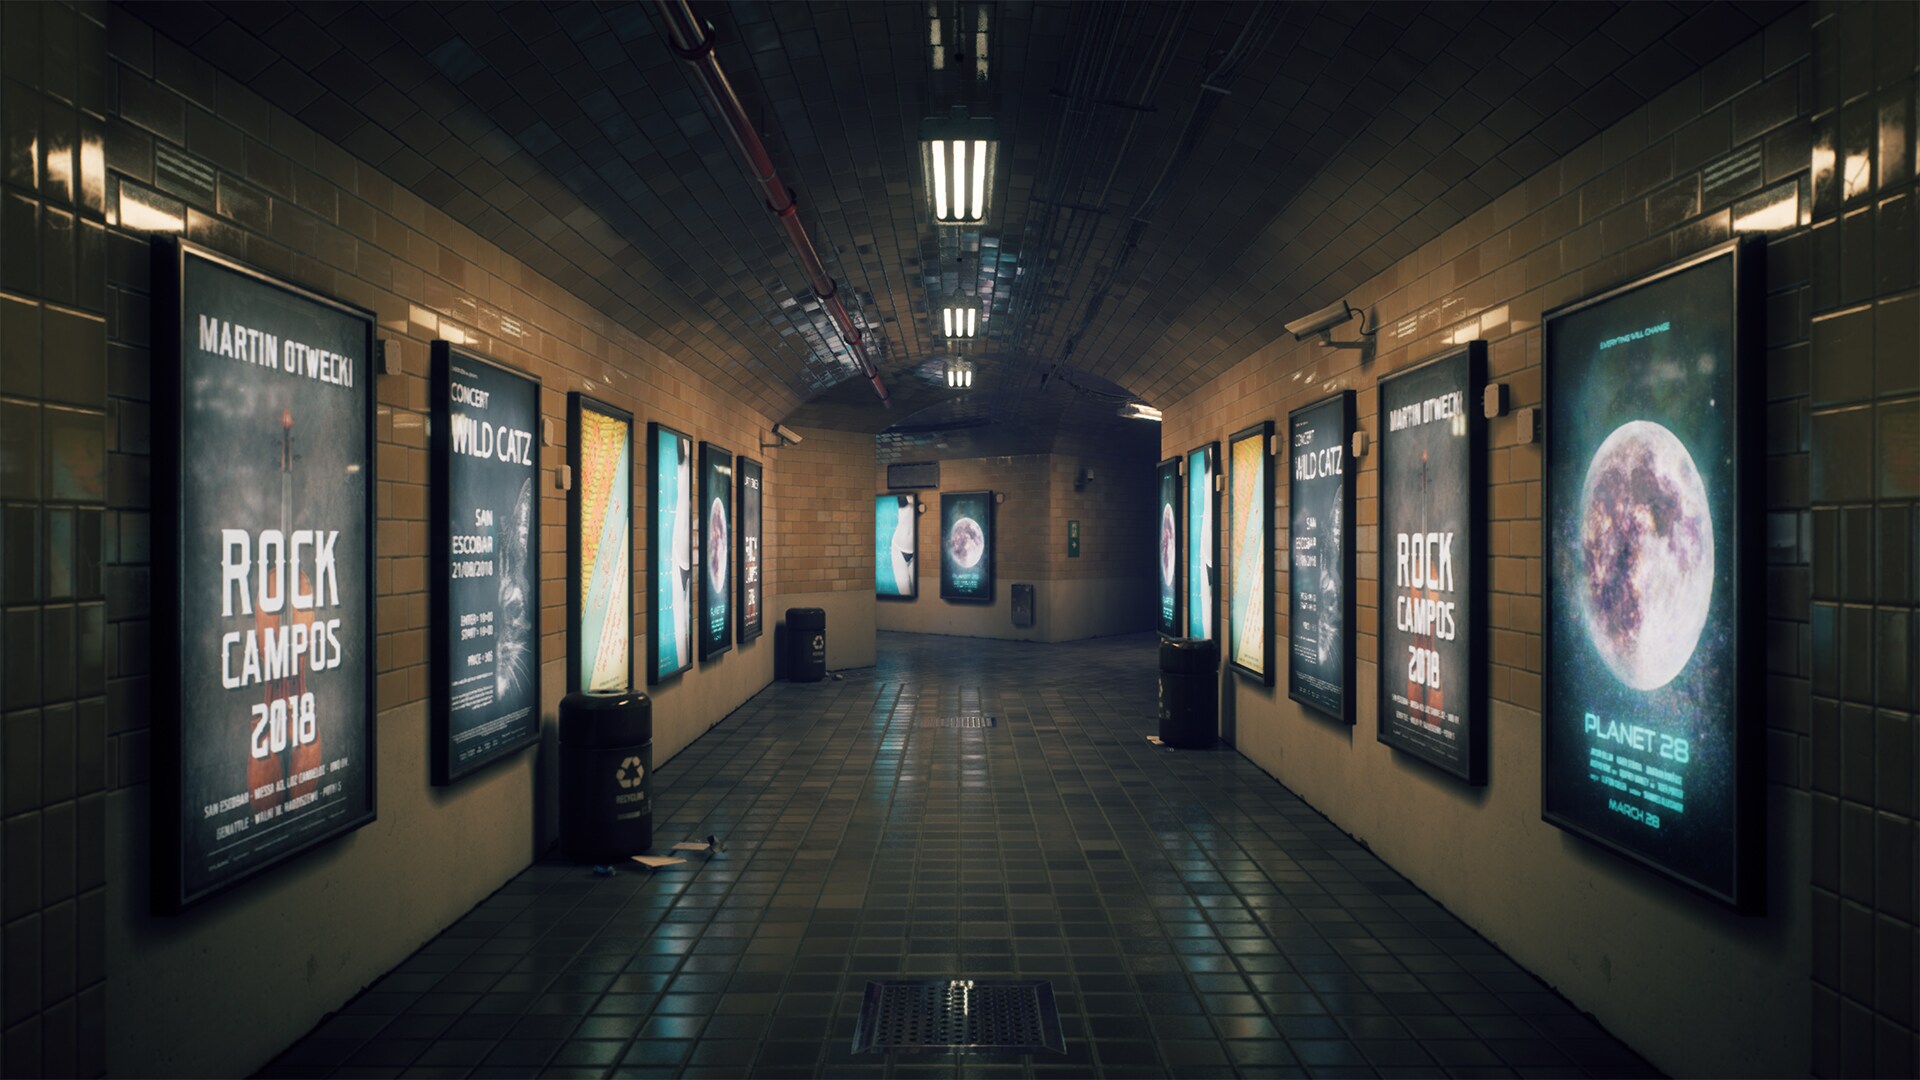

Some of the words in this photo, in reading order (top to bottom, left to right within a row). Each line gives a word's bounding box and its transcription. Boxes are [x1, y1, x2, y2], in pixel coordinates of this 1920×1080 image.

[200, 314, 278, 369] MARTIN
[284, 339, 353, 388] OTWECKI
[451, 382, 489, 410] CONCERT
[1389, 402, 1421, 432] MARTIN
[451, 413, 493, 459] WILD
[496, 425, 532, 466] CATZ
[1318, 445, 1343, 478] CATZ
[475, 508, 494, 527] SAN
[452, 536, 494, 554] ESCOBAR
[1397, 533, 1454, 592] ROCK
[221, 529, 340, 617] ROCK
[1397, 596, 1455, 641] CAMPOS
[222, 618, 341, 690] CAMPOS
[1408, 646, 1440, 689] 2018
[251, 692, 316, 759] 2018
[1584, 712, 1657, 754] PLANET
[1659, 733, 1690, 764] 28
[1608, 798, 1645, 822] MARCH
[1645, 811, 1660, 829] 28
